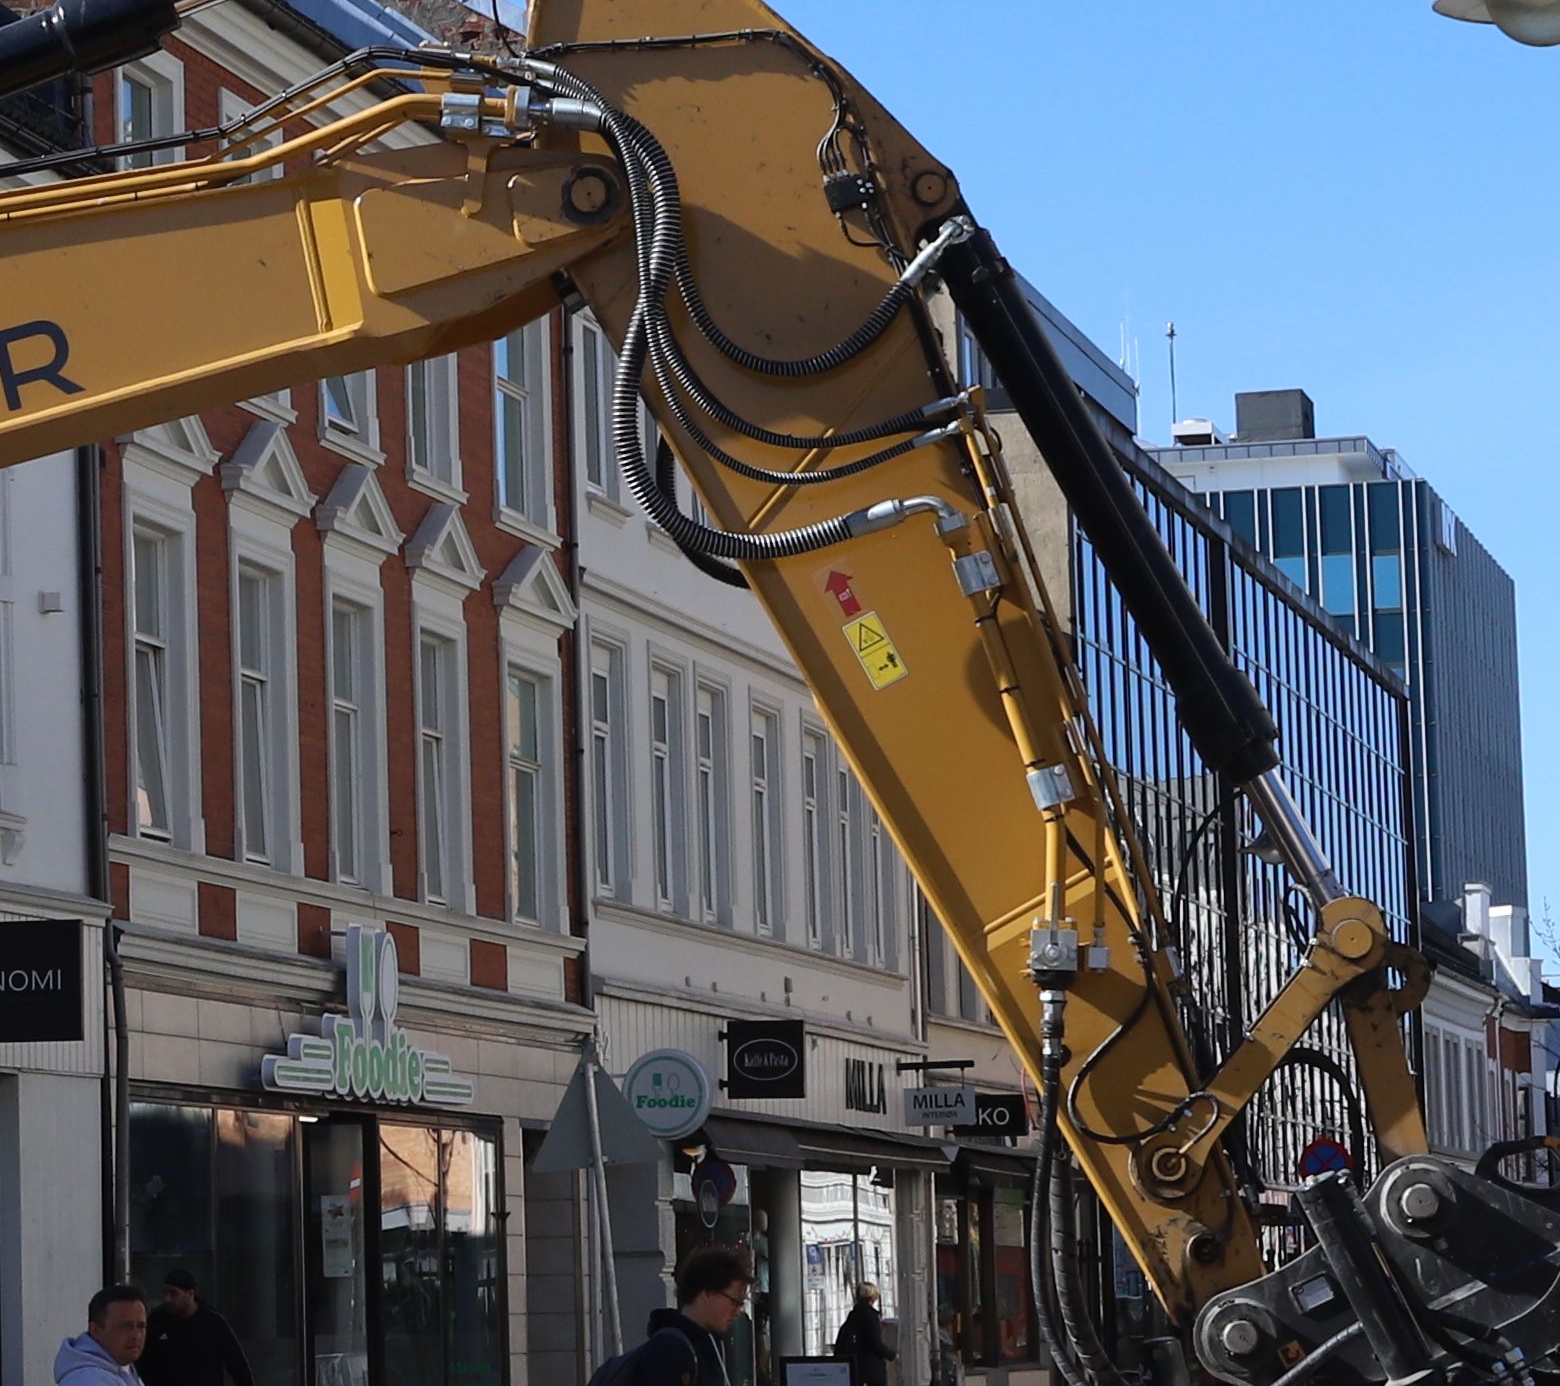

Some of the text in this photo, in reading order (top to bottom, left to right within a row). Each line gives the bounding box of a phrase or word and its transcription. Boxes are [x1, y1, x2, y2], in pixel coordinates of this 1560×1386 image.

[335, 1021, 422, 1099] Foodie
[636, 1095, 696, 1109] Foodie
[845, 1058, 887, 1115] MILLA
[913, 1093, 965, 1109] MILLA
